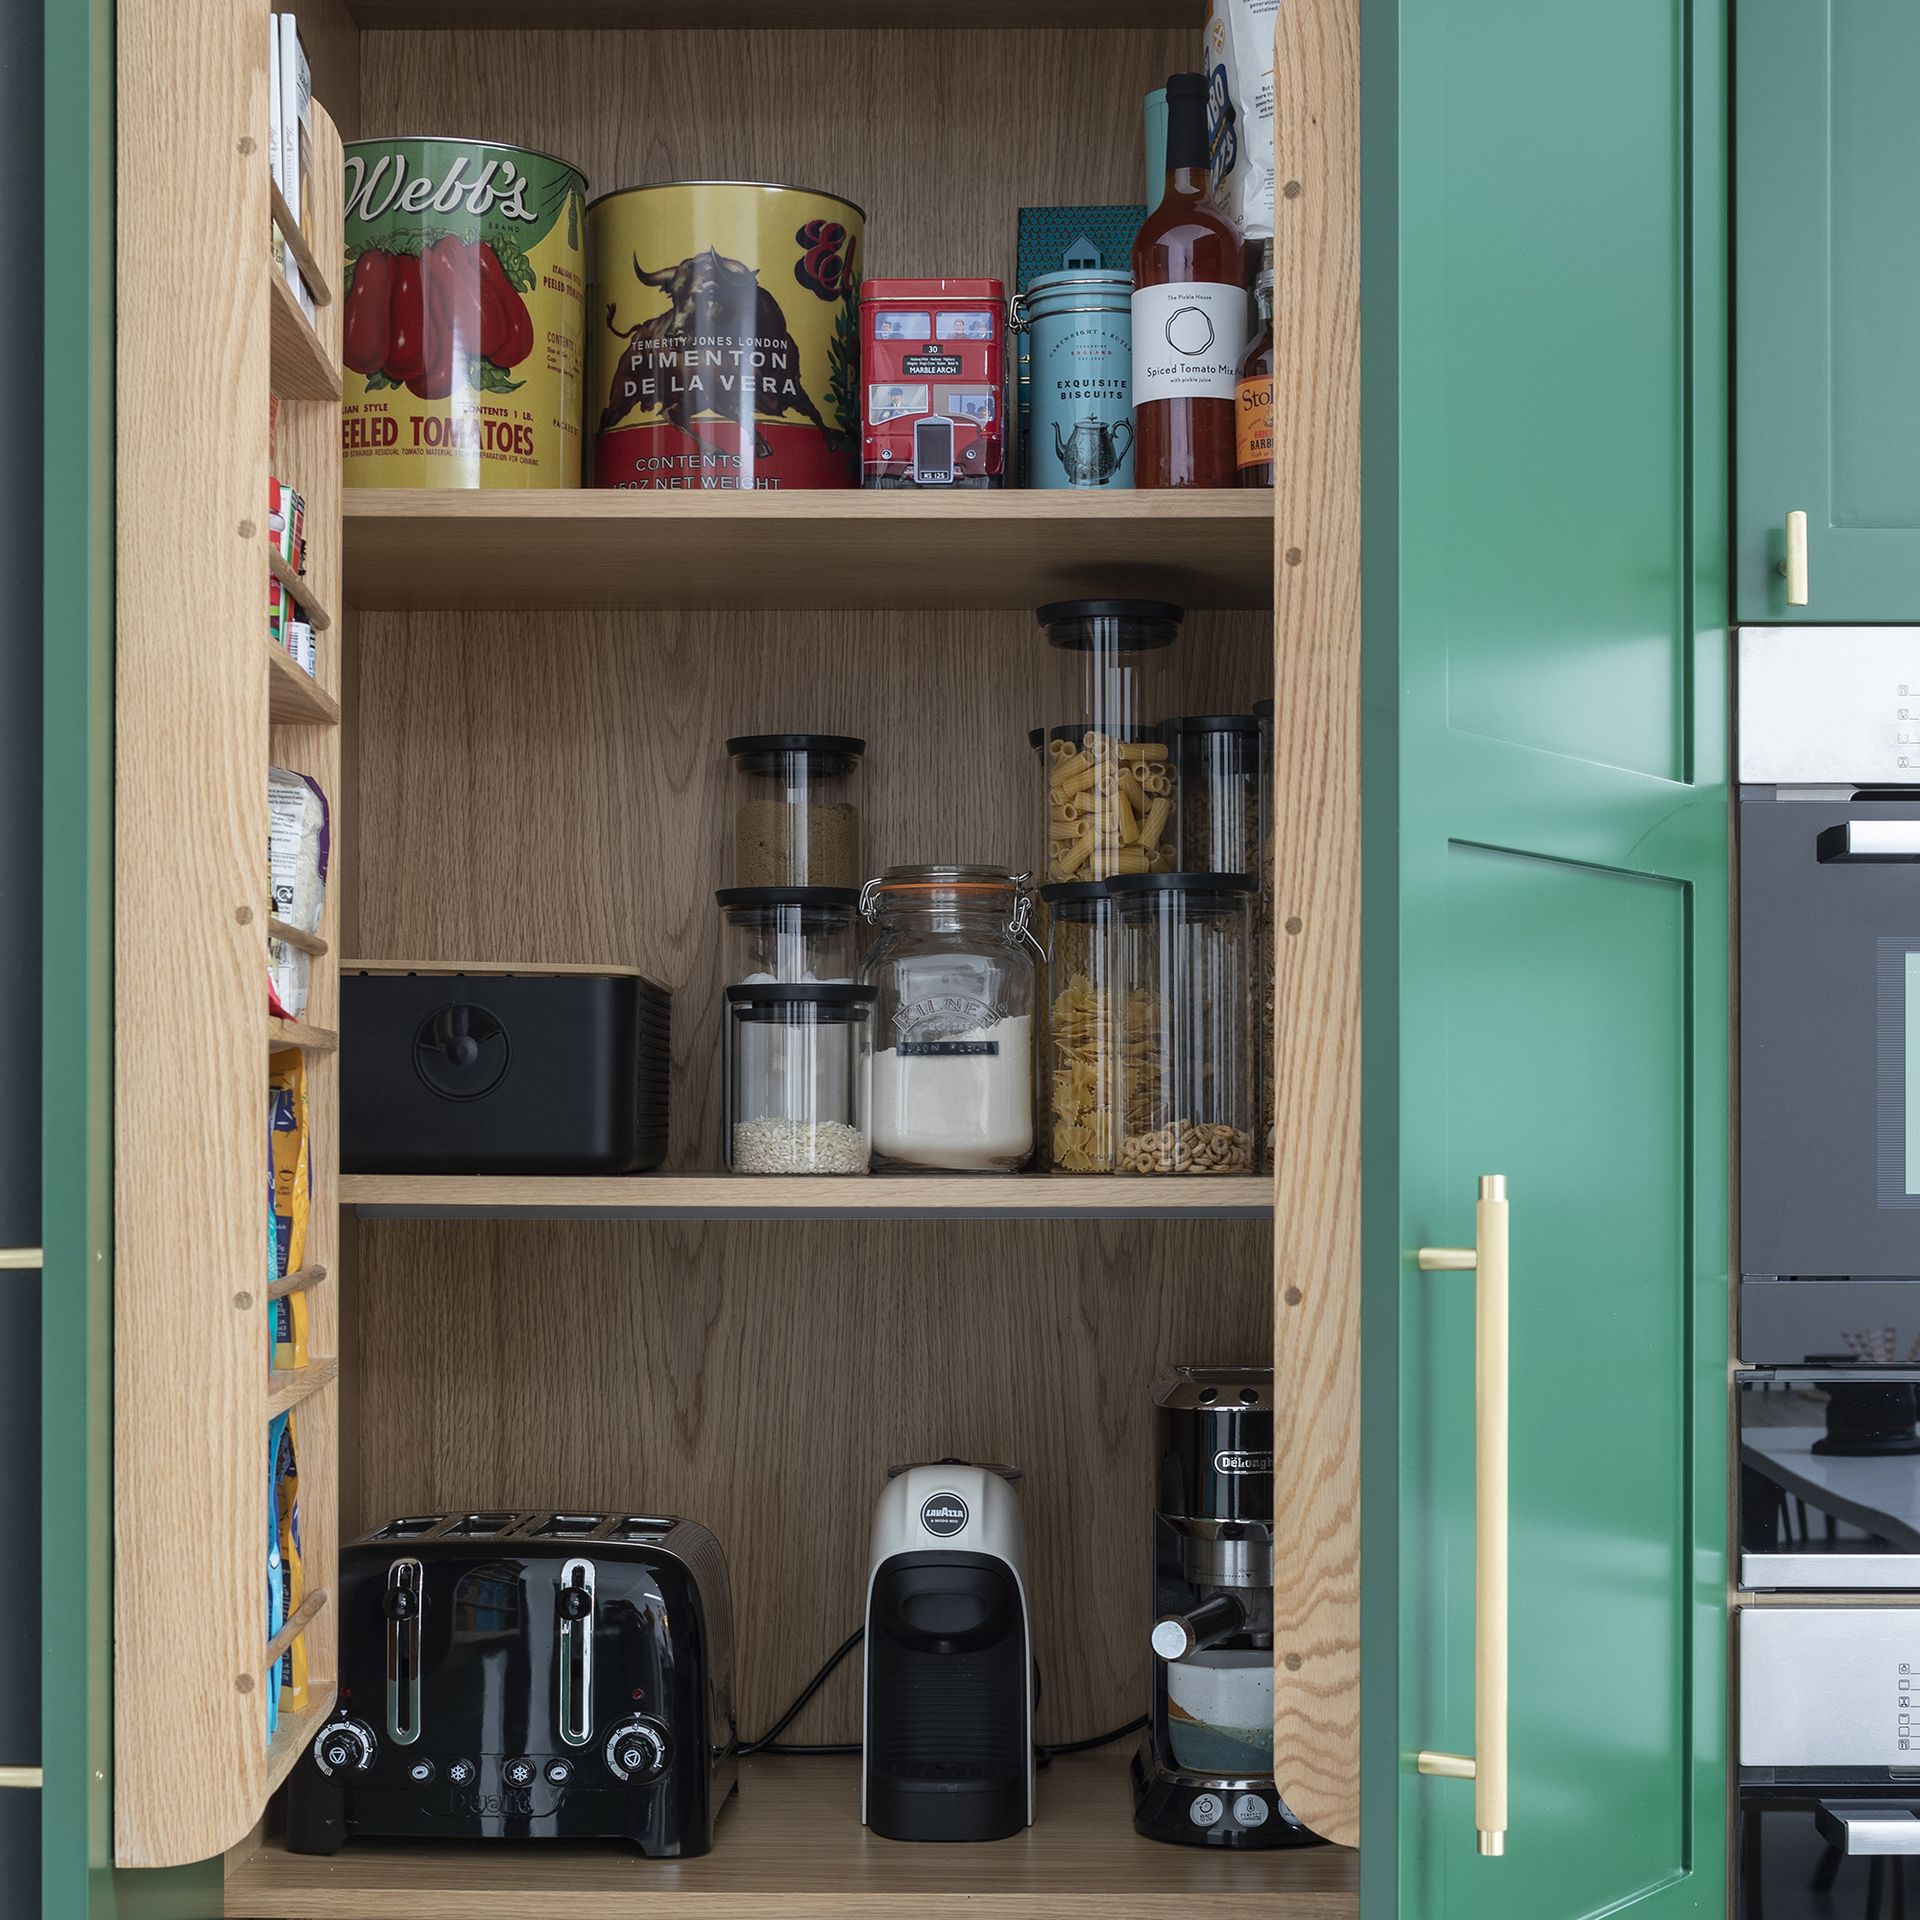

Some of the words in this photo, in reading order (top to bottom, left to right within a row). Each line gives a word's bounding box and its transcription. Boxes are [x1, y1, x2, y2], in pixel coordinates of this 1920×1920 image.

[343, 154, 537, 222] Webb's
[488, 222, 520, 233] BRAND
[543, 275, 565, 293] PEELED
[632, 337, 687, 351] TEMERITY
[692, 336, 733, 346] JONES
[738, 337, 788, 350] LONDON
[928, 345, 938, 353] 30
[631, 350, 788, 371] PIMENTON
[1147, 363, 1177, 378] Spiced
[1180, 363, 1216, 374] Tomato
[1218, 364, 1234, 376] Mix
[624, 378, 655, 398] DE
[671, 376, 704, 393] LA
[719, 375, 797, 395] VERA
[1057, 379, 1127, 389] EXQUISITE
[1061, 391, 1123, 400] BISCUITS
[363, 403, 388, 412] STYLE
[522, 411, 534, 421] LB.
[342, 416, 398, 449] EELED
[410, 416, 534, 456] TOMATOES
[402, 448, 424, 456] TOMATO
[635, 454, 744, 472] CONTENTS
[655, 476, 695, 490] NET
[700, 475, 782, 490] WEIGHT
[925, 1507, 964, 1518] LAVAZZA
